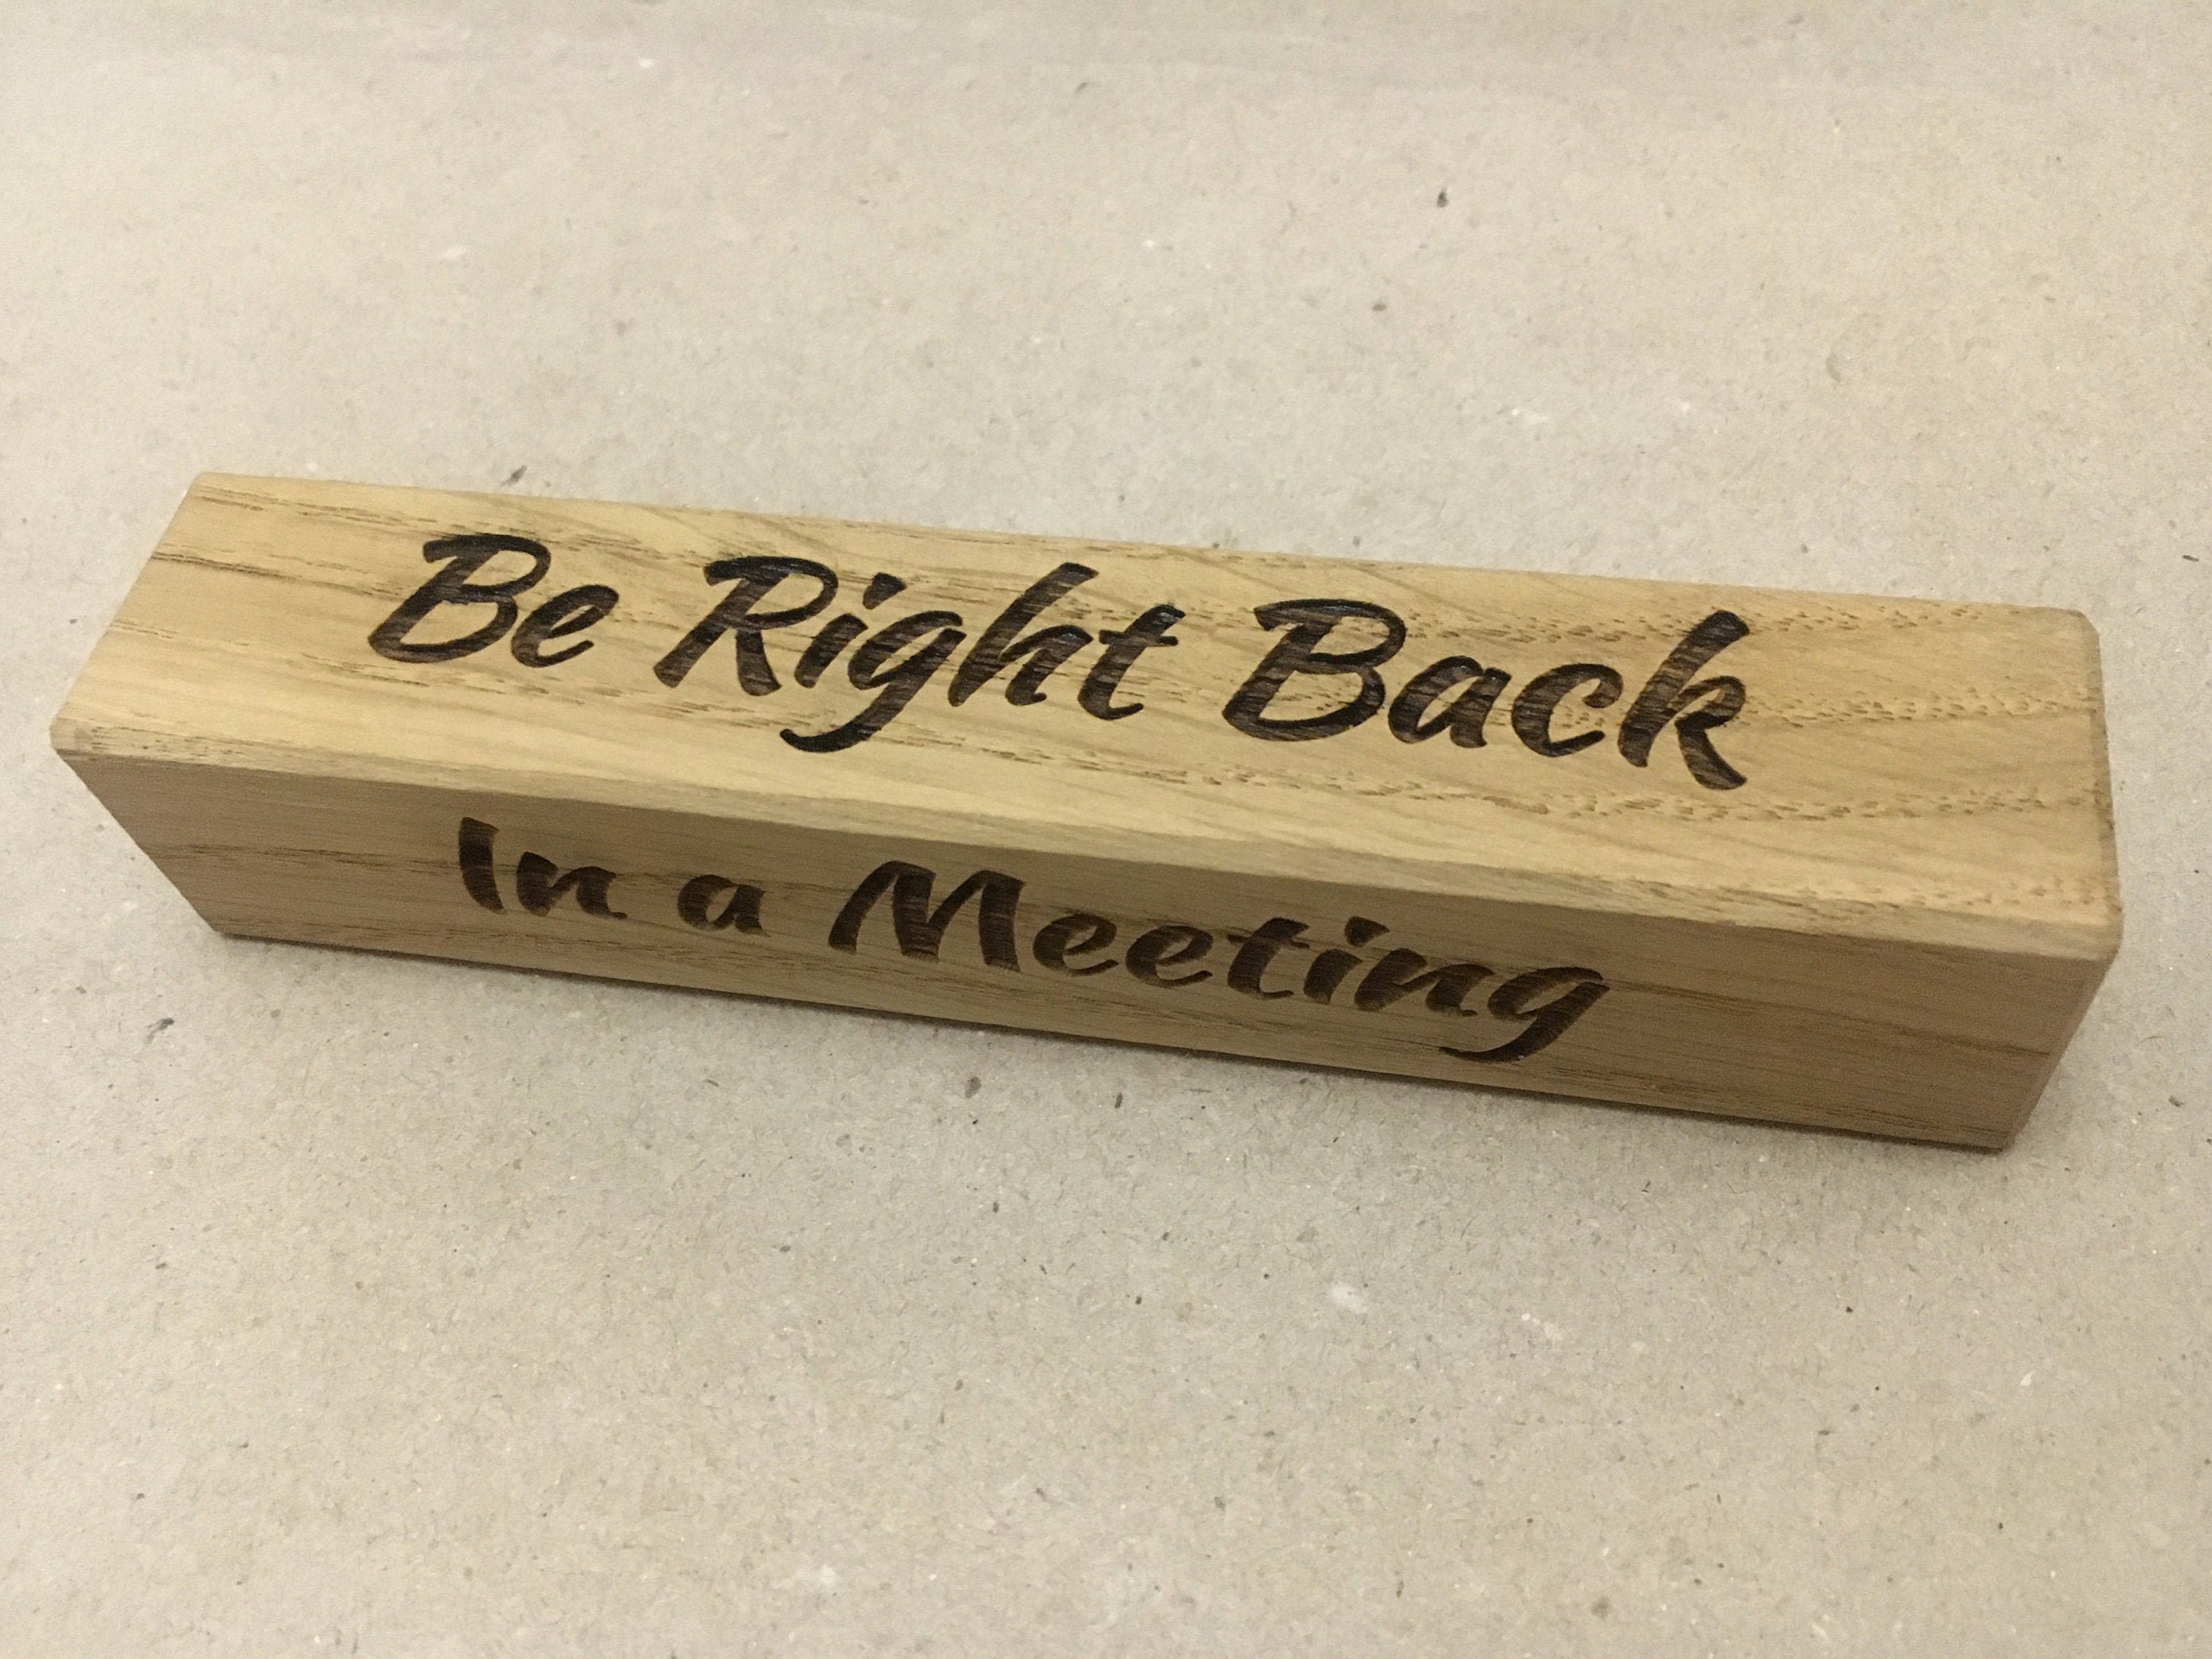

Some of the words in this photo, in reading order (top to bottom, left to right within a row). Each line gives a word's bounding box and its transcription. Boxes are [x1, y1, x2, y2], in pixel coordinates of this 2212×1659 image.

[368, 531, 620, 666] Be
[654, 555, 1186, 753] Right
[1223, 598, 1751, 790] Back
[457, 816, 626, 920] In
[677, 873, 769, 935] a
[828, 859, 1609, 1064] Meeting
